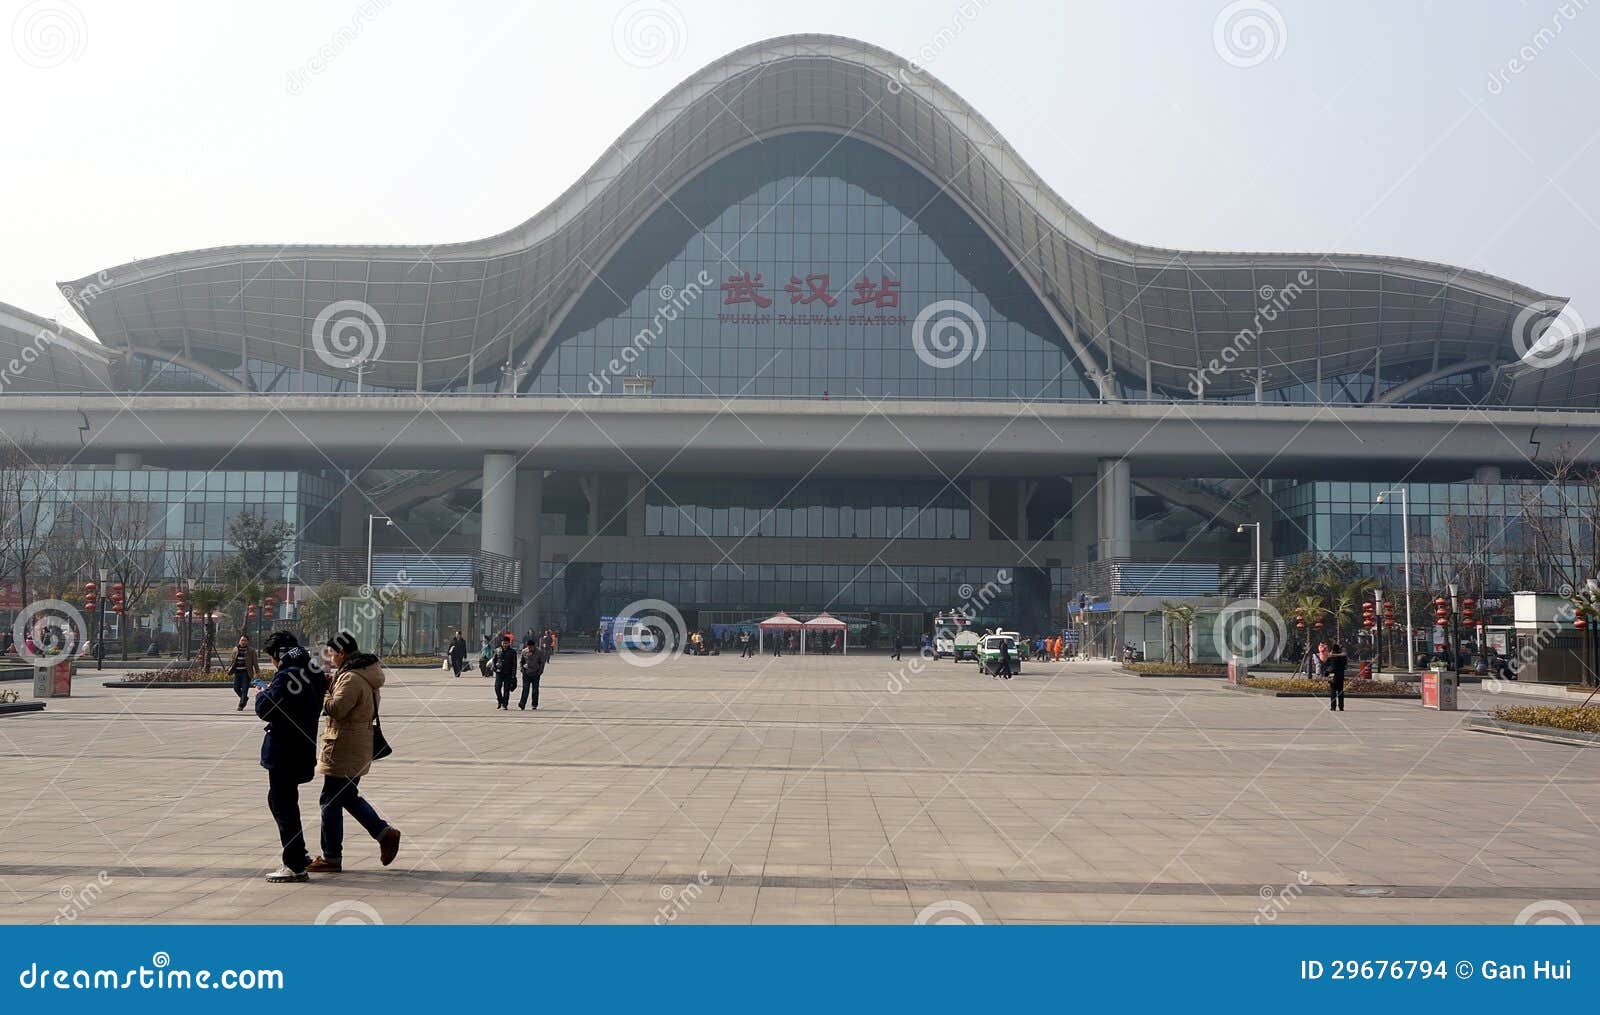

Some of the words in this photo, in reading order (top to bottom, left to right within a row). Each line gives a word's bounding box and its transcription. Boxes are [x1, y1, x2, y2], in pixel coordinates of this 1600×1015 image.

[720, 272, 901, 308] 武汉站
[717, 313, 771, 326] WUHAN
[778, 314, 842, 326] RAILWAY
[849, 315, 907, 327] STATION
